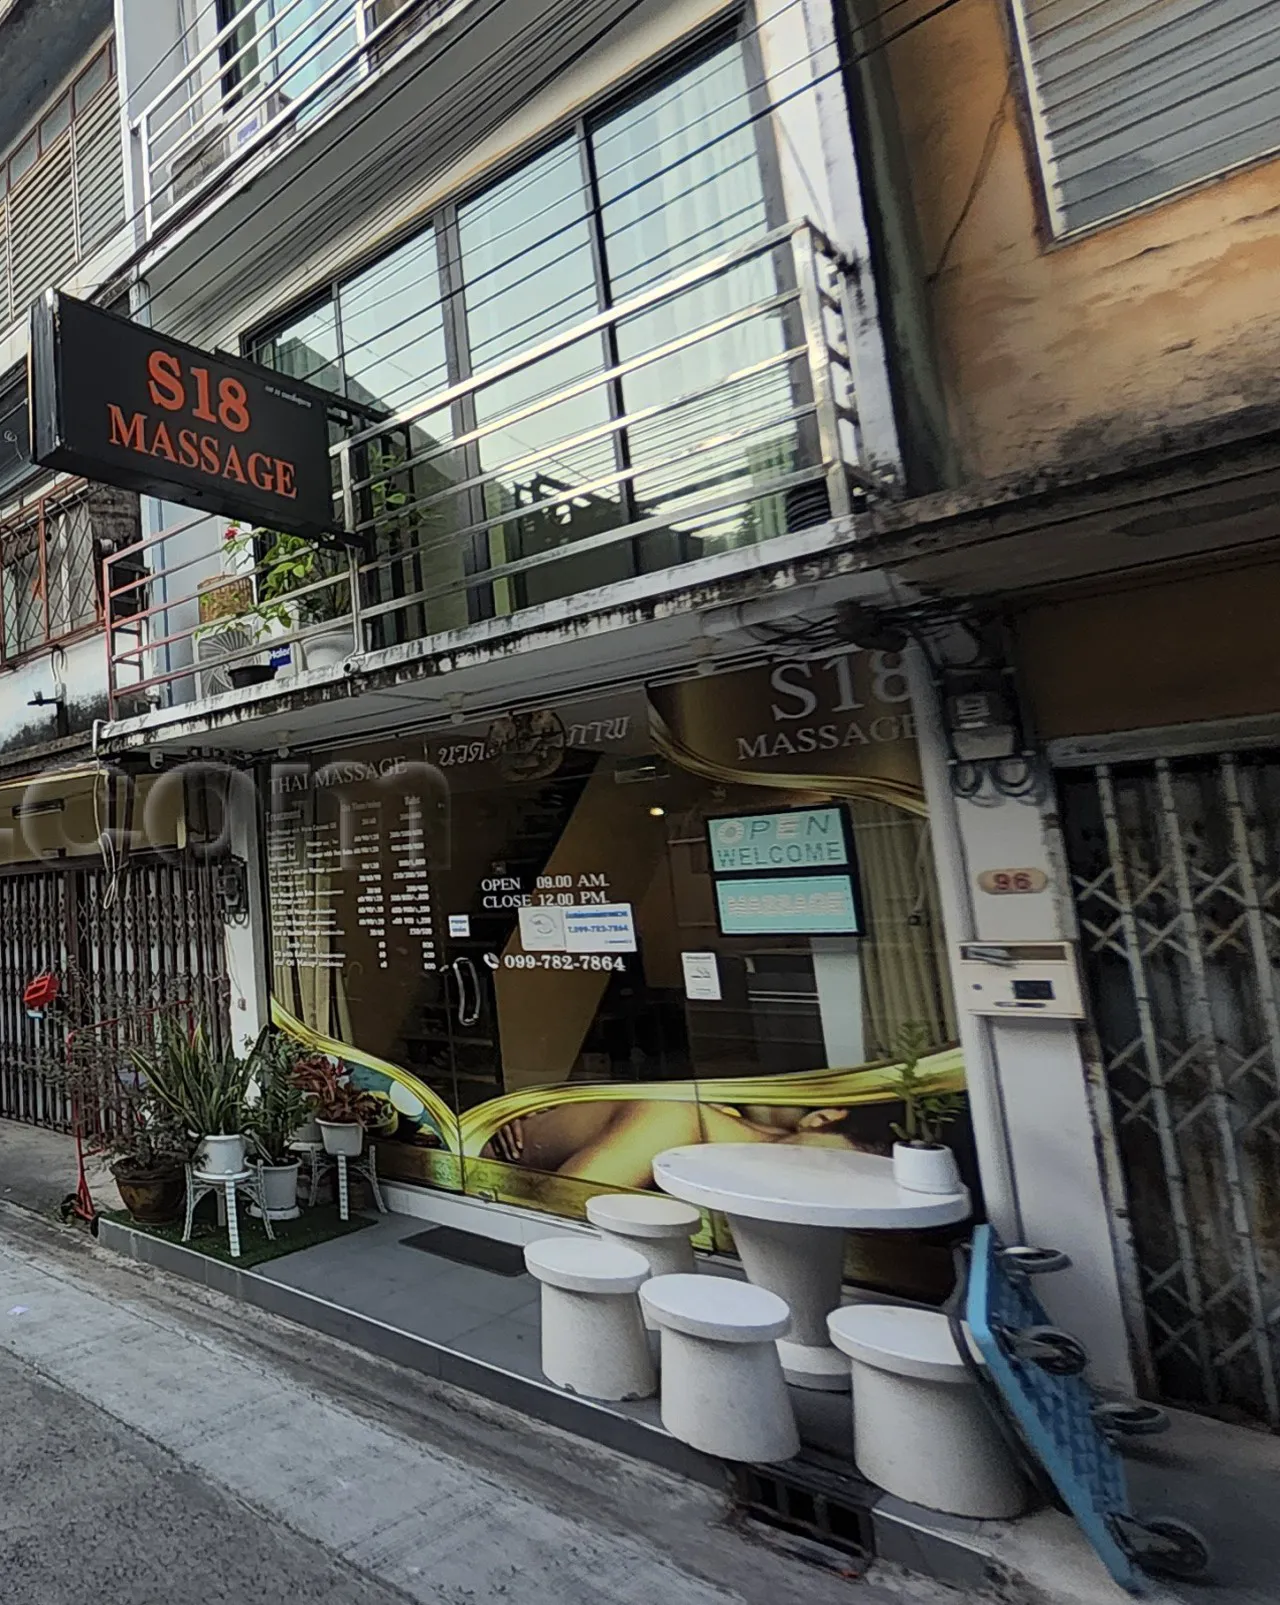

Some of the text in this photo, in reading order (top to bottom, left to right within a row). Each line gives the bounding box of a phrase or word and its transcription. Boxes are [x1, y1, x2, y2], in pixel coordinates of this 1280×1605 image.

[147, 350, 250, 433] S18
[107, 403, 298, 499] MASSAGE
[770, 650, 917, 721] S18
[735, 713, 919, 761] MASSAGE
[267, 755, 409, 796] THAI MASSAGE
[718, 814, 831, 844] OPEN
[717, 841, 842, 867] WELCOME
[481, 873, 609, 892] OPEN 09.00 AM.
[483, 890, 610, 909] CLOSE 12.00 PM.
[504, 954, 626, 972] 099-782-7864
